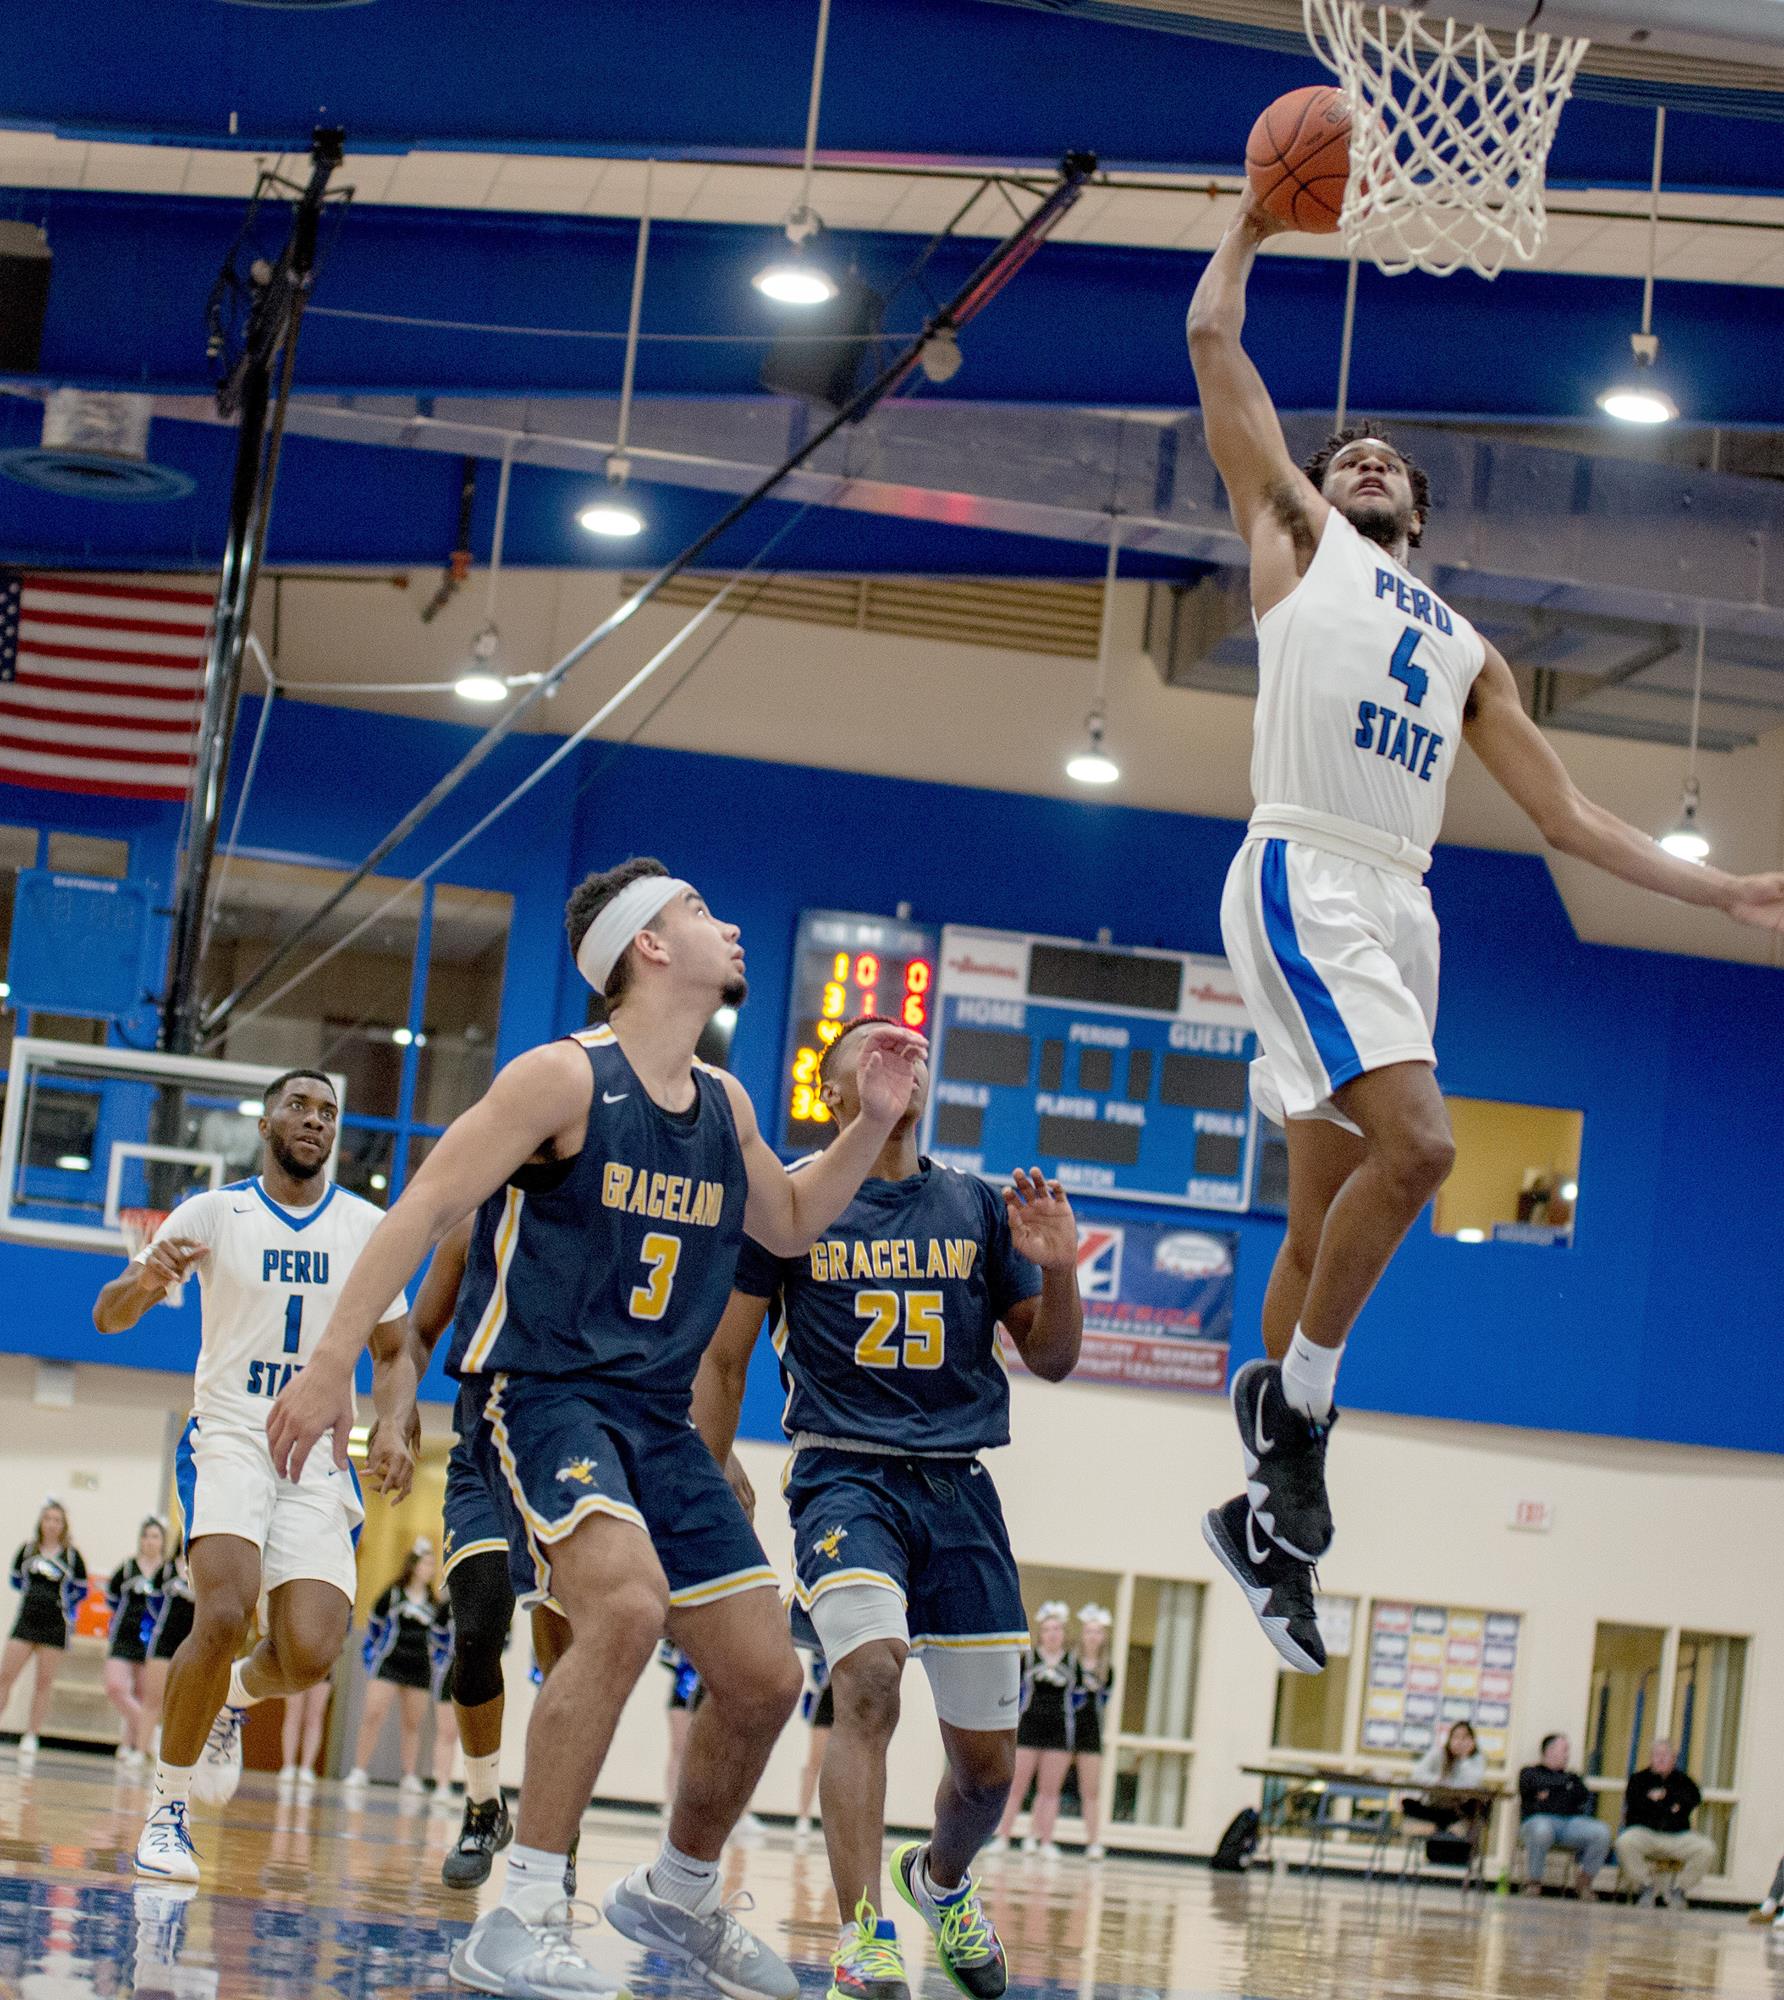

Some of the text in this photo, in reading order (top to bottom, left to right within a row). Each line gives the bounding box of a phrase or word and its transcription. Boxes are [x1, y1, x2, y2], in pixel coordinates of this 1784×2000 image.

[1375, 567, 1453, 636] PERU
[1388, 625, 1429, 708] 4
[1355, 700, 1444, 782] STATE
[956, 1001, 1025, 1028] HOME
[1069, 1023, 1129, 1047] PERIOD
[1169, 1022, 1246, 1053] GUEST
[1035, 1092, 1146, 1127] PLAYER FOUL
[601, 1161, 724, 1228] GRACELAND
[263, 1249, 329, 1284] PERU
[629, 1231, 682, 1321] 3
[810, 1238, 977, 1281] GRACELAND
[283, 1294, 304, 1354] 1
[854, 1290, 945, 1370] 25
